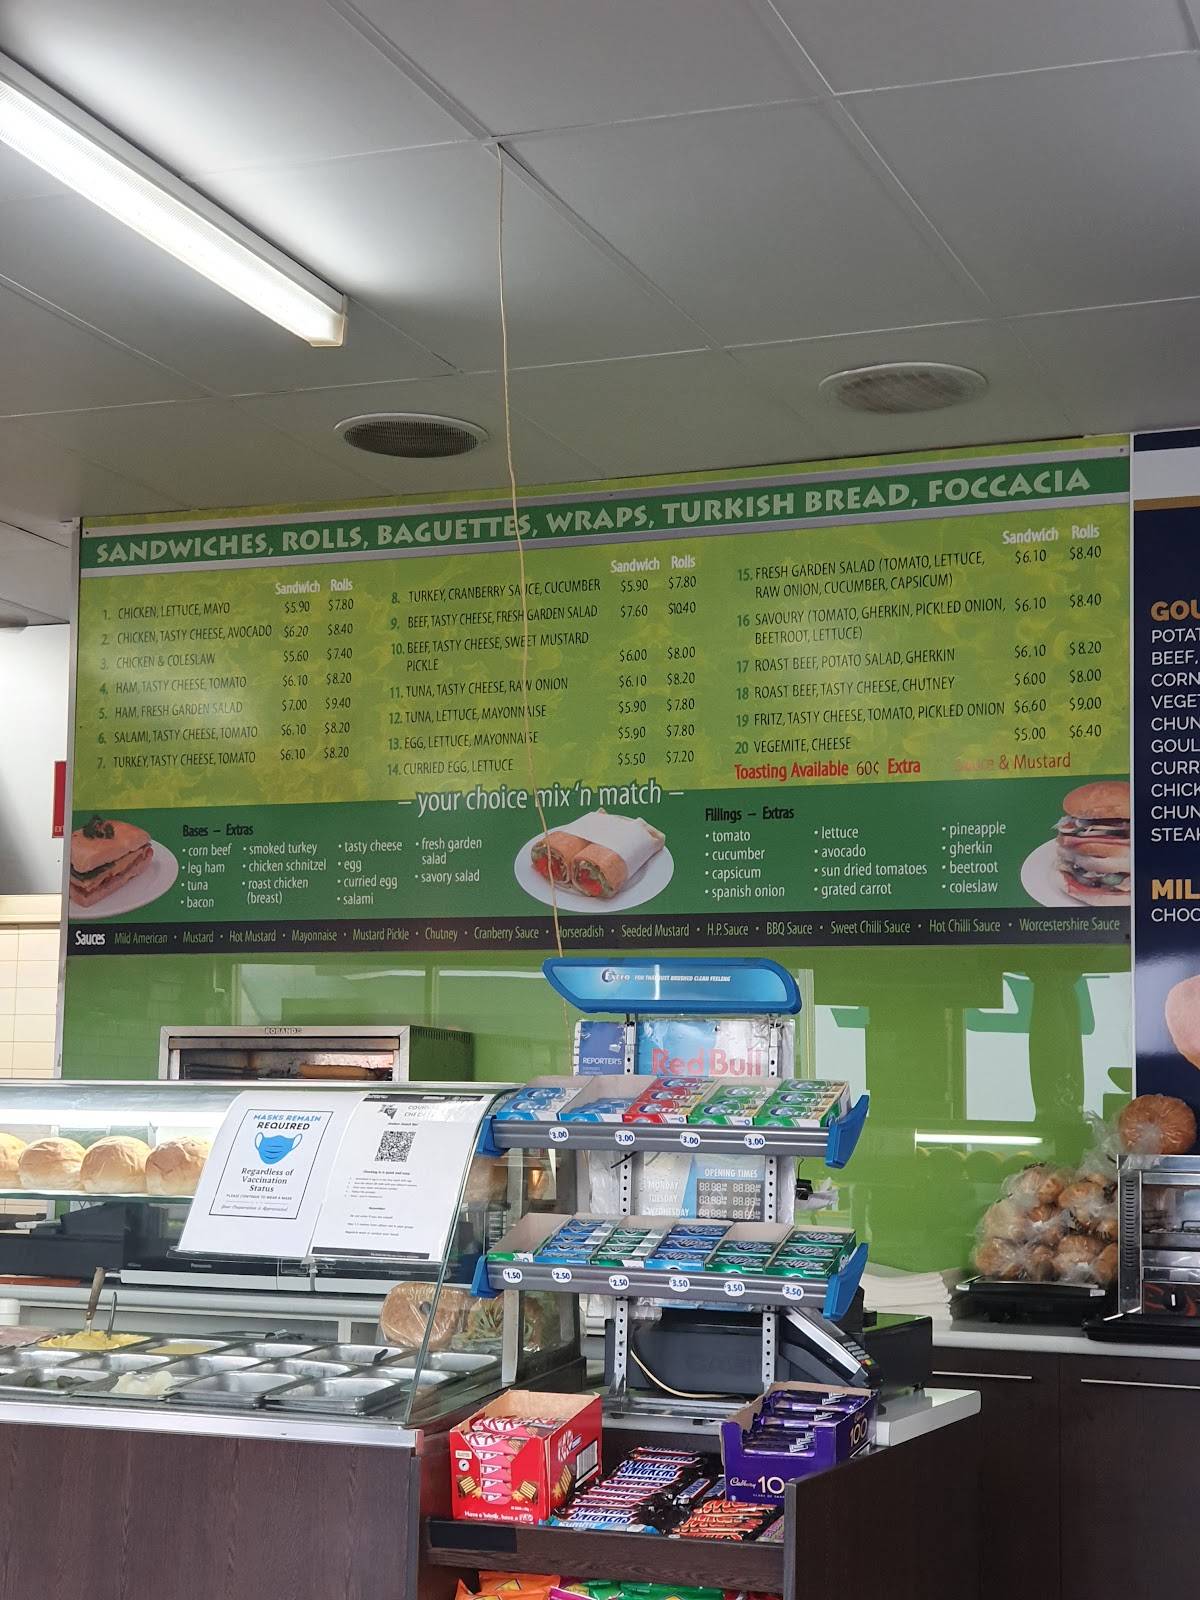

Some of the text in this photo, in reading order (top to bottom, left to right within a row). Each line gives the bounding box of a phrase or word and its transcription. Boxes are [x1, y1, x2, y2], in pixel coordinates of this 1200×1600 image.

[97, 468, 1090, 565] SANDWICHES, ROLLS, BAGUETTES, WRAPS, TURKISH BREAD, FOCCACIA
[1002, 524, 1099, 544] Sandwich Rolls
[610, 555, 695, 574] Sandwich Rolls
[755, 545, 1101, 580] FRESH GARDEN SALAD LETTUCE, $6.10 $8.40
[275, 578, 353, 596] Sandwich Rolls
[409, 576, 696, 603] TURKEY, CRANBERRY CUCUMBER $5.90 $7.80
[755, 573, 953, 599] RAW ONION, CUCUMBER, CAPSICUM)
[118, 598, 353, 620] CHICKEN, LETTUCE, MAYO $5.90 $7.80
[527, 605, 648, 621] GARDEN SALAD $7.60
[755, 594, 1101, 626] SAVOURY GHERKIN, PICKLED ONION, $6.10 $8.40
[117, 623, 353, 645] CHICKEN, TASTY CHEESE, AVOCADO $6.20 $8.40
[284, 648, 352, 662] $5.60 $7.40
[432, 632, 696, 662] TASTY CHEESE, MUSTARD $6.00 $8.00
[754, 641, 1101, 672] ROAST GHERKIN $6.10 $8.20
[1152, 650, 1199, 665] BEEF,
[407, 659, 438, 672] PICKLE
[283, 672, 352, 687] $6.10 $8.20
[406, 673, 695, 698] TUNA, TASTY CHEESE, ONION $6.10 $8.20
[902, 669, 1101, 692] CHUTNEY $8.00
[405, 698, 695, 724] TUNA, LETTUCE, $5.90 $7.80
[869, 697, 1101, 721] TOMATO, PICKLED ONION $6.60 $9.00
[617, 724, 694, 740] $5.90 $7.80
[754, 725, 1101, 754] VEGEMITE, CHEESE $5.00 $6.40
[617, 750, 694, 766] $5.50 $7.20
[1013, 752, 1071, 769] Mustard
[735, 762, 787, 783] Toasting
[791, 760, 848, 778] Available
[887, 758, 920, 774] Extra
[418, 780, 662, 817] your choice mix match
[705, 806, 794, 824] Fillings Extras
[712, 830, 750, 842] tomato
[821, 826, 858, 840] lettuce
[949, 822, 1006, 837] pineapple
[249, 842, 317, 855] smoked turkey
[422, 837, 482, 849] fresh garden
[249, 859, 326, 872] chicken schnitzel
[875, 862, 928, 876] tomatoes
[421, 870, 480, 884] savory salad
[712, 867, 761, 881] capsicum
[949, 880, 998, 893] coleslaw
[187, 897, 214, 908] bacon
[247, 892, 282, 904] (breast)
[75, 918, 1120, 945] Sauces Mayonnaise Chutney Cranberry Sauce Seeded Mustard Sweet Chilli Sauce Worcestershire Sauce
[652, 1048, 761, 1077] Red Bull
[257, 1122, 310, 1130] REQUIRED
[241, 1168, 283, 1176] Regardless
[242, 1176, 287, 1184] Vaccination
[705, 1168, 758, 1177] OPENING TIMES
